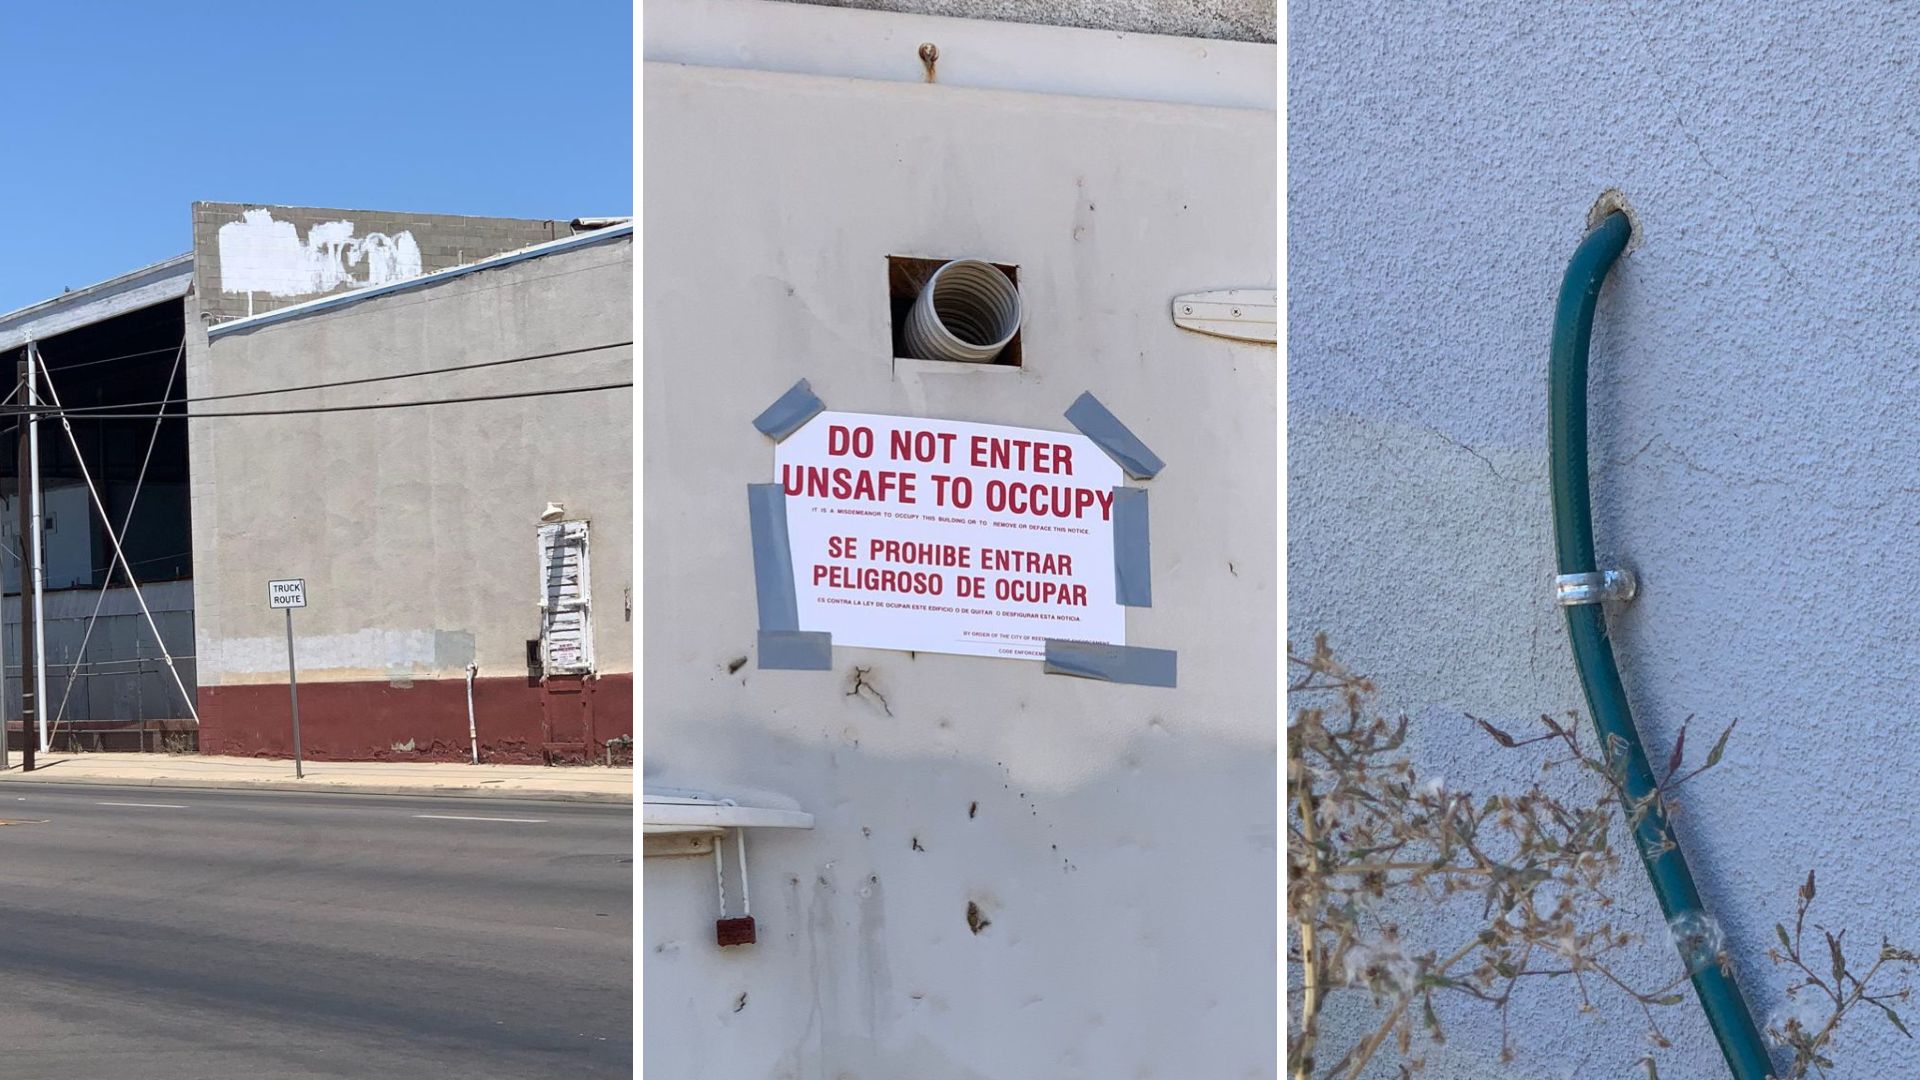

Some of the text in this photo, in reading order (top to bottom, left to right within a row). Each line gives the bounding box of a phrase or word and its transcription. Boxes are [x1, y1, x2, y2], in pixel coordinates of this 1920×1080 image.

[828, 425, 1073, 476] DO NOT ENTER
[782, 464, 1113, 521] UNSAFE TO OCCUPY
[837, 509, 881, 517] MISDEMEANOR
[938, 516, 966, 524] BUILDING
[993, 521, 1017, 529] REMOVE
[1028, 524, 1052, 532] DEFACE
[828, 536, 1072, 576] SE PROHIBE ENTRAR
[273, 584, 300, 592] TRUCK
[274, 595, 301, 603] ROUTE
[813, 565, 1087, 606] PELIGROSO DE OCUPAR
[826, 597, 852, 605] CONTRA
[885, 602, 911, 610] OCUPAR
[970, 608, 993, 616] QUITAR
[1002, 611, 1039, 619] DESFIGURAR
